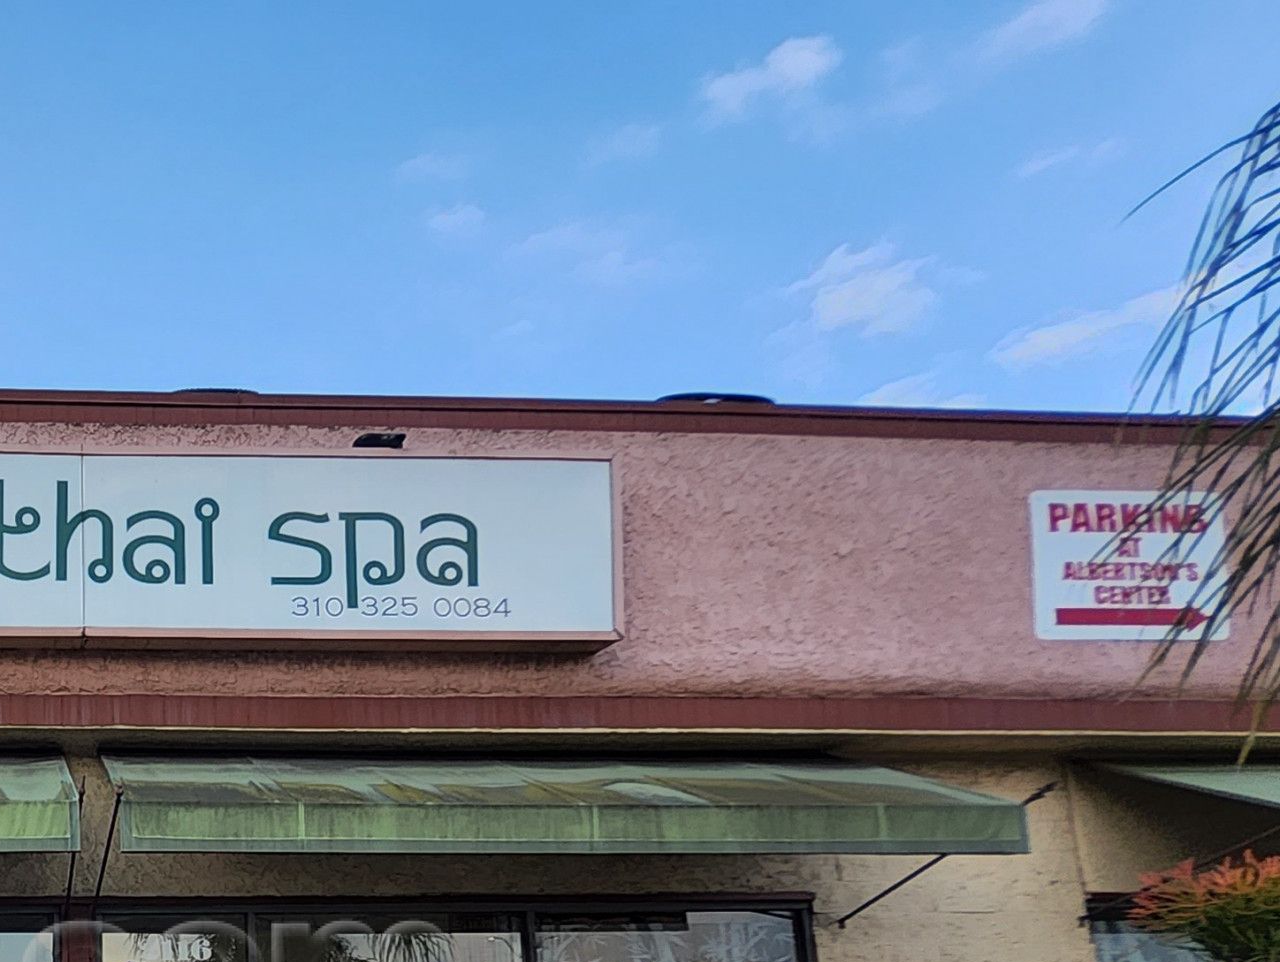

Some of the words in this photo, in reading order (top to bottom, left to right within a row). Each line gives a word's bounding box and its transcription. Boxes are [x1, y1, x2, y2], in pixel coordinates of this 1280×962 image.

[1048, 502, 1209, 534] PARKING
[1117, 537, 1142, 558] AT
[268, 511, 479, 609] spa
[1094, 585, 1170, 605] CENTER
[291, 596, 344, 617] 310
[360, 597, 418, 617] 325
[433, 598, 511, 618] 0084
